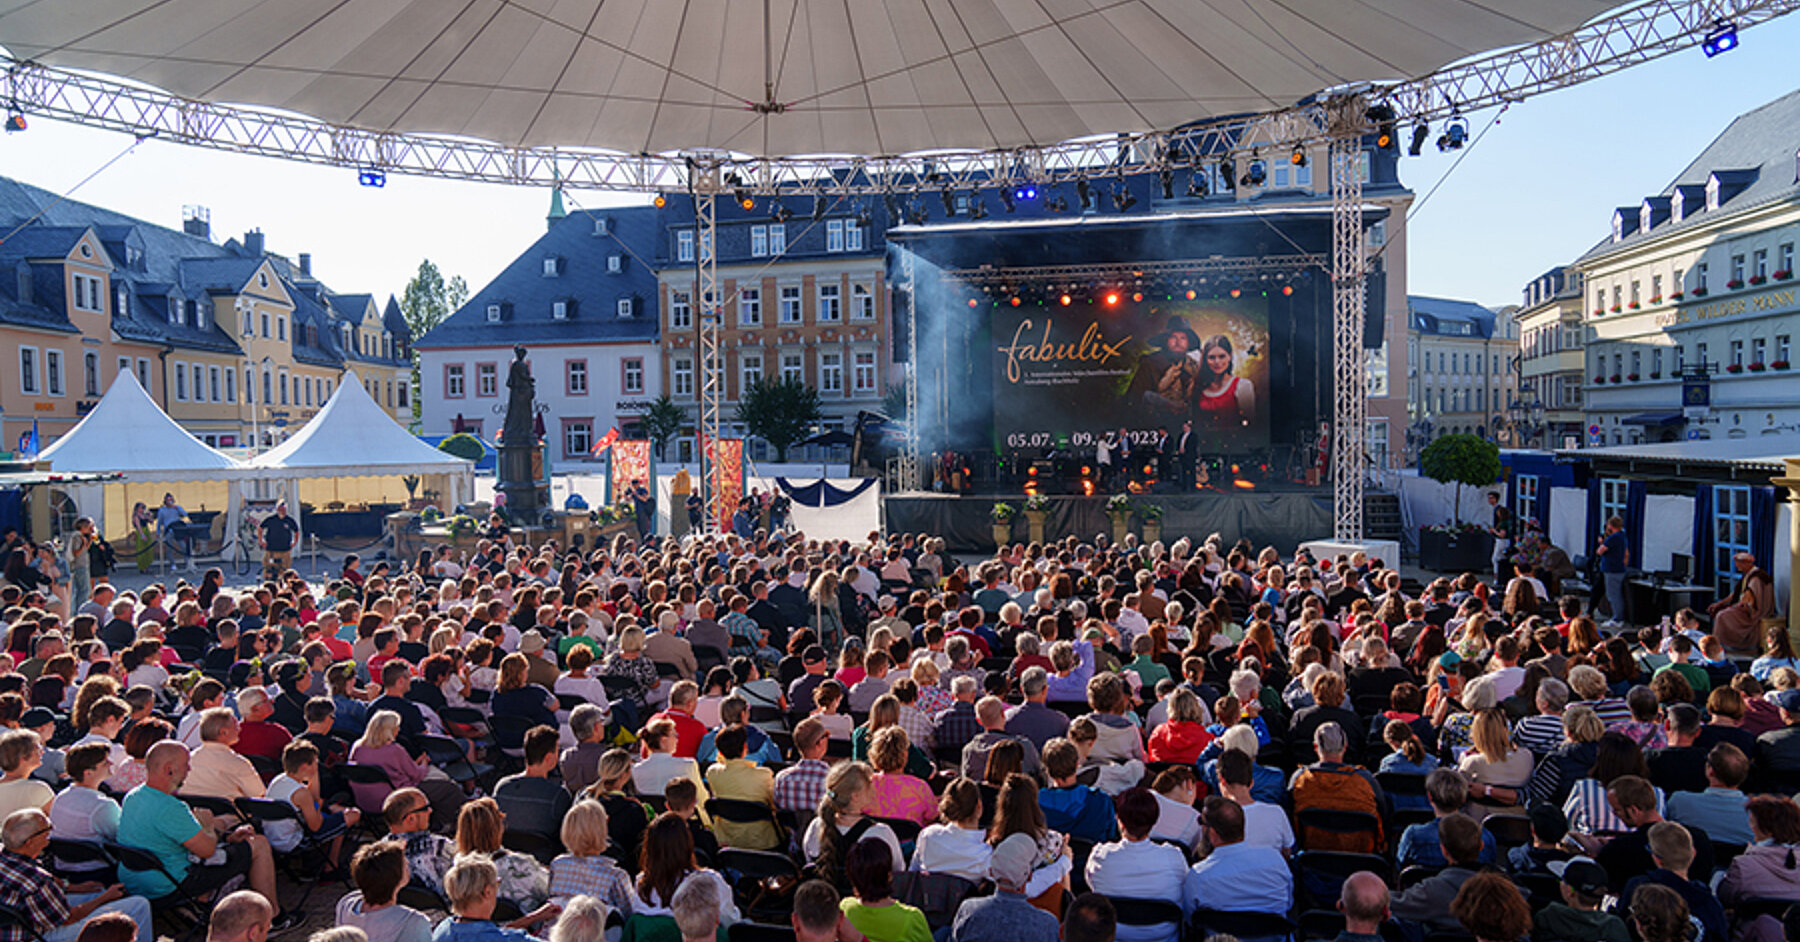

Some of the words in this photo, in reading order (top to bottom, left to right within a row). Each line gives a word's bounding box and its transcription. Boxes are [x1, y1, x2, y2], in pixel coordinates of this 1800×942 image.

[1696, 299, 1746, 320] WILDER
[1753, 290, 1795, 311] MANN
[998, 319, 1133, 383] fabulix
[1007, 432, 1055, 447] 05.07.
